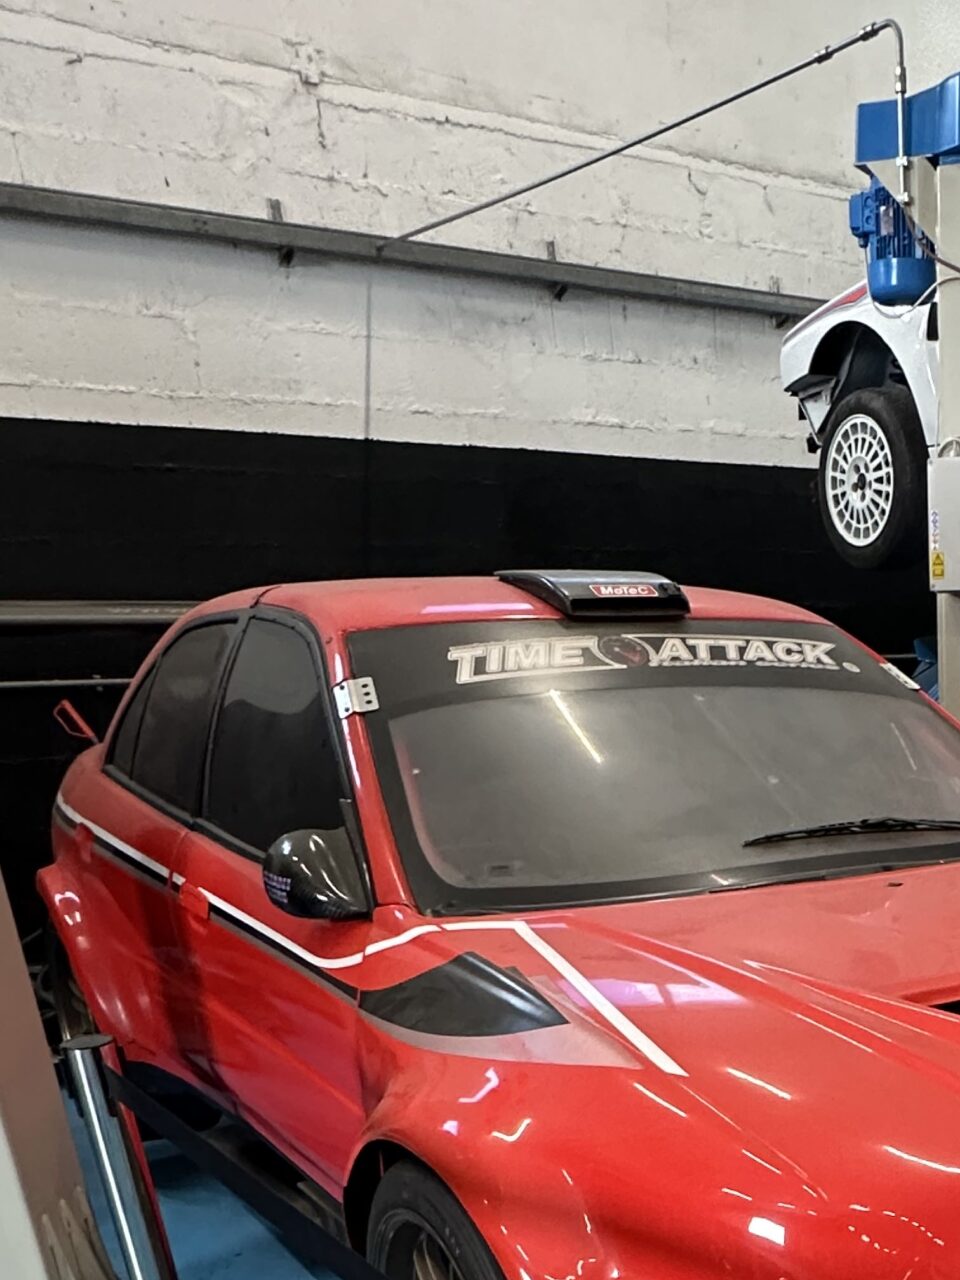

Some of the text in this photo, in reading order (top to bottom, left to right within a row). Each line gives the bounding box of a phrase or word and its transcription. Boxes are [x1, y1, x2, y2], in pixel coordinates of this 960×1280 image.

[600, 586, 649, 595] MoTeC
[448, 636, 838, 684] TIME ATTACK
